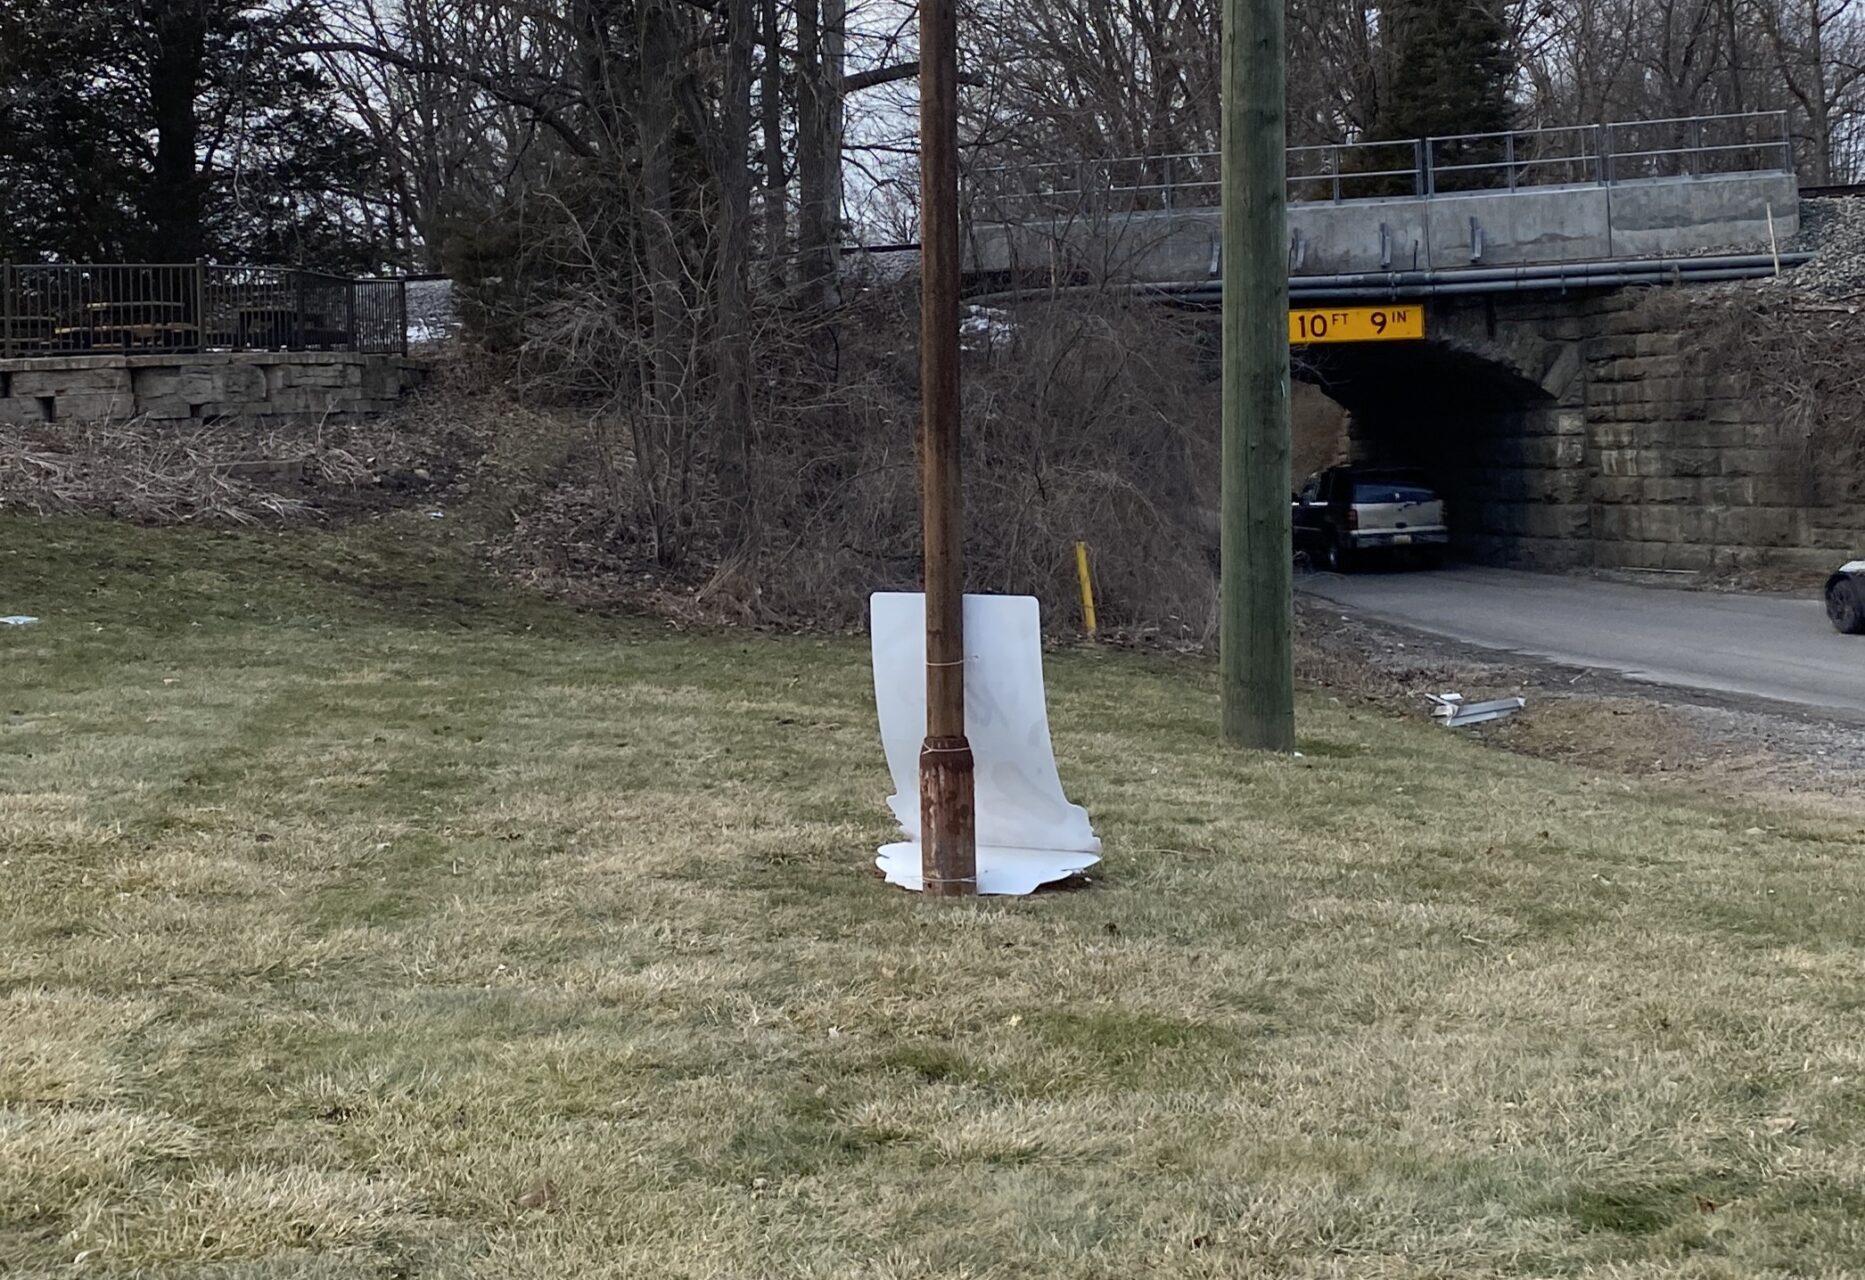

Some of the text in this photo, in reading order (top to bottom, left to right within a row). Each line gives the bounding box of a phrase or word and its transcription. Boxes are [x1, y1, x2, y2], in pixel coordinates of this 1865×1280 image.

[1298, 310, 1407, 338] 10 FT 9 IN
